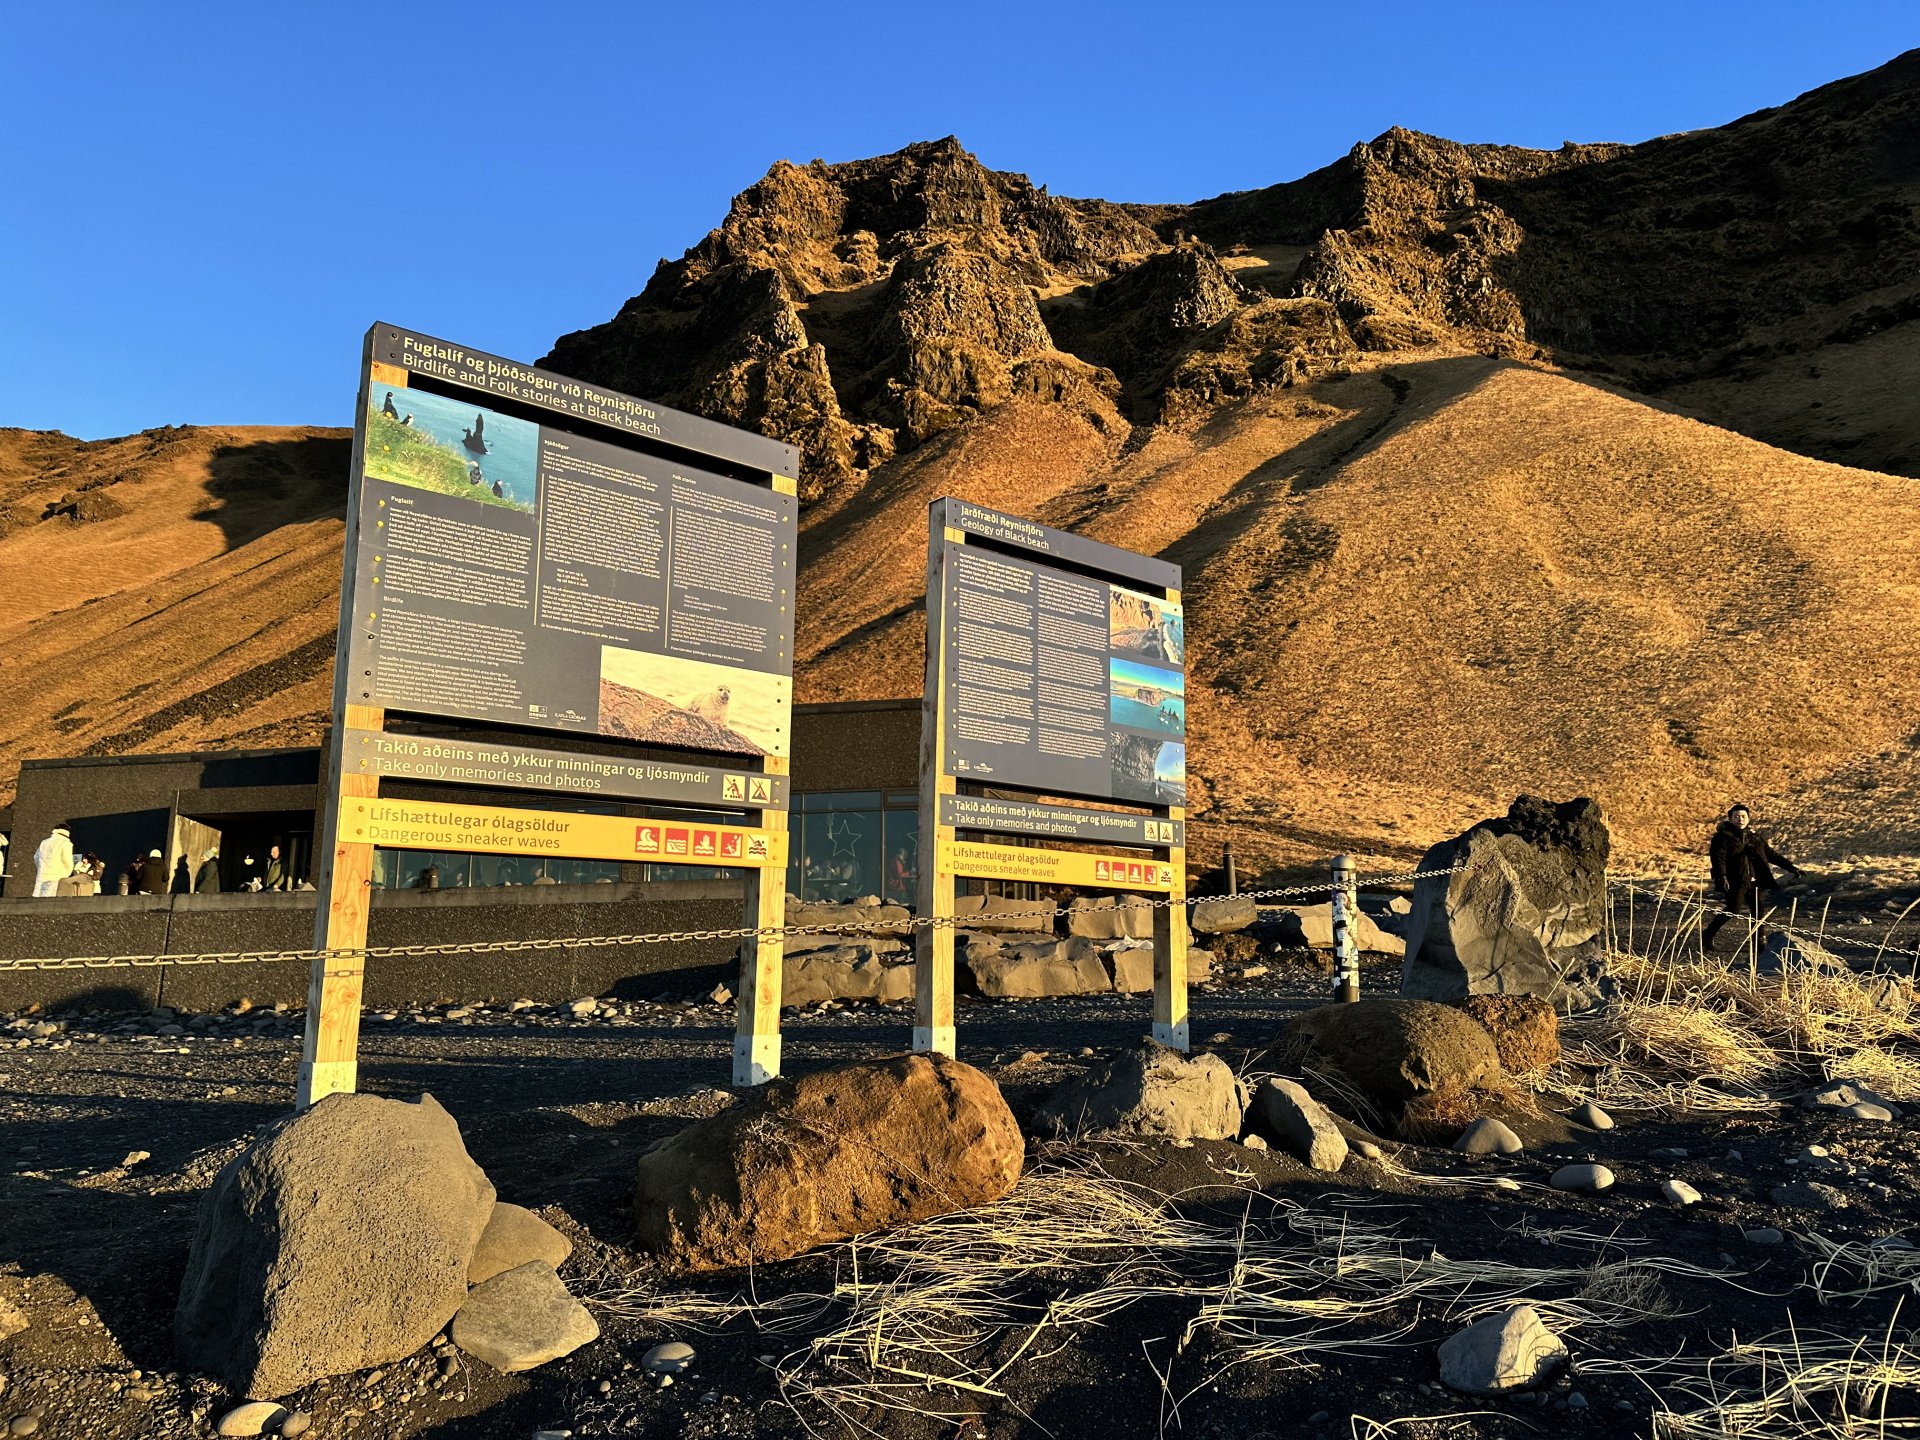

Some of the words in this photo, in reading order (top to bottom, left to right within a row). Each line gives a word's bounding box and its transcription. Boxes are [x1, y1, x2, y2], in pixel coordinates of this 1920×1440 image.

[403, 353, 456, 378] Birdlife
[460, 371, 486, 386] and
[490, 377, 519, 395] Folk
[522, 388, 567, 409] stories
[571, 402, 585, 414] at
[588, 405, 622, 425] Black
[625, 415, 660, 436] beach
[404, 337, 464, 363] Fuglalíf
[466, 357, 484, 372] og
[488, 360, 558, 391] þjóðsögur
[561, 384, 580, 397] við
[584, 389, 656, 420] Reynisfjöru
[961, 505, 999, 524] Jarðfræði
[1000, 517, 1044, 537] Reynisfjöru
[961, 517, 994, 536] Geology
[995, 527, 1004, 537] of
[1005, 530, 1027, 544] Black
[1027, 535, 1049, 550] beach
[373, 757, 411, 773] Take
[415, 762, 448, 778] only
[451, 766, 523, 782] memories
[526, 772, 552, 785] and
[555, 774, 601, 789] photos
[374, 739, 419, 756] Takið
[423, 745, 474, 761] aðeins
[478, 751, 510, 764] með
[513, 753, 553, 768] ykkur
[556, 758, 625, 777] minningar
[627, 766, 644, 780] og
[646, 765, 711, 784] ljósmyndir
[370, 807, 489, 829] Lífshættulegar
[492, 815, 570, 833] ólagsöldur
[955, 800, 979, 812] Takið
[980, 803, 1008, 815] aðeins
[1009, 807, 1026, 817] með
[1028, 808, 1050, 819] ykkur
[1051, 811, 1089, 824] minningar
[1090, 816, 1100, 826] og
[1101, 815, 1138, 829] ljósmyndir
[955, 813, 976, 825] Take
[977, 816, 994, 828] only
[996, 819, 1034, 830] memories
[1035, 821, 1050, 831] and
[1051, 823, 1077, 834] photos
[369, 825, 452, 844] Dangerous
[456, 832, 514, 847] sneaker
[517, 836, 560, 849] waves
[953, 860, 998, 873] Dangerous
[999, 865, 1030, 876] sneaker
[1031, 868, 1055, 878] waves
